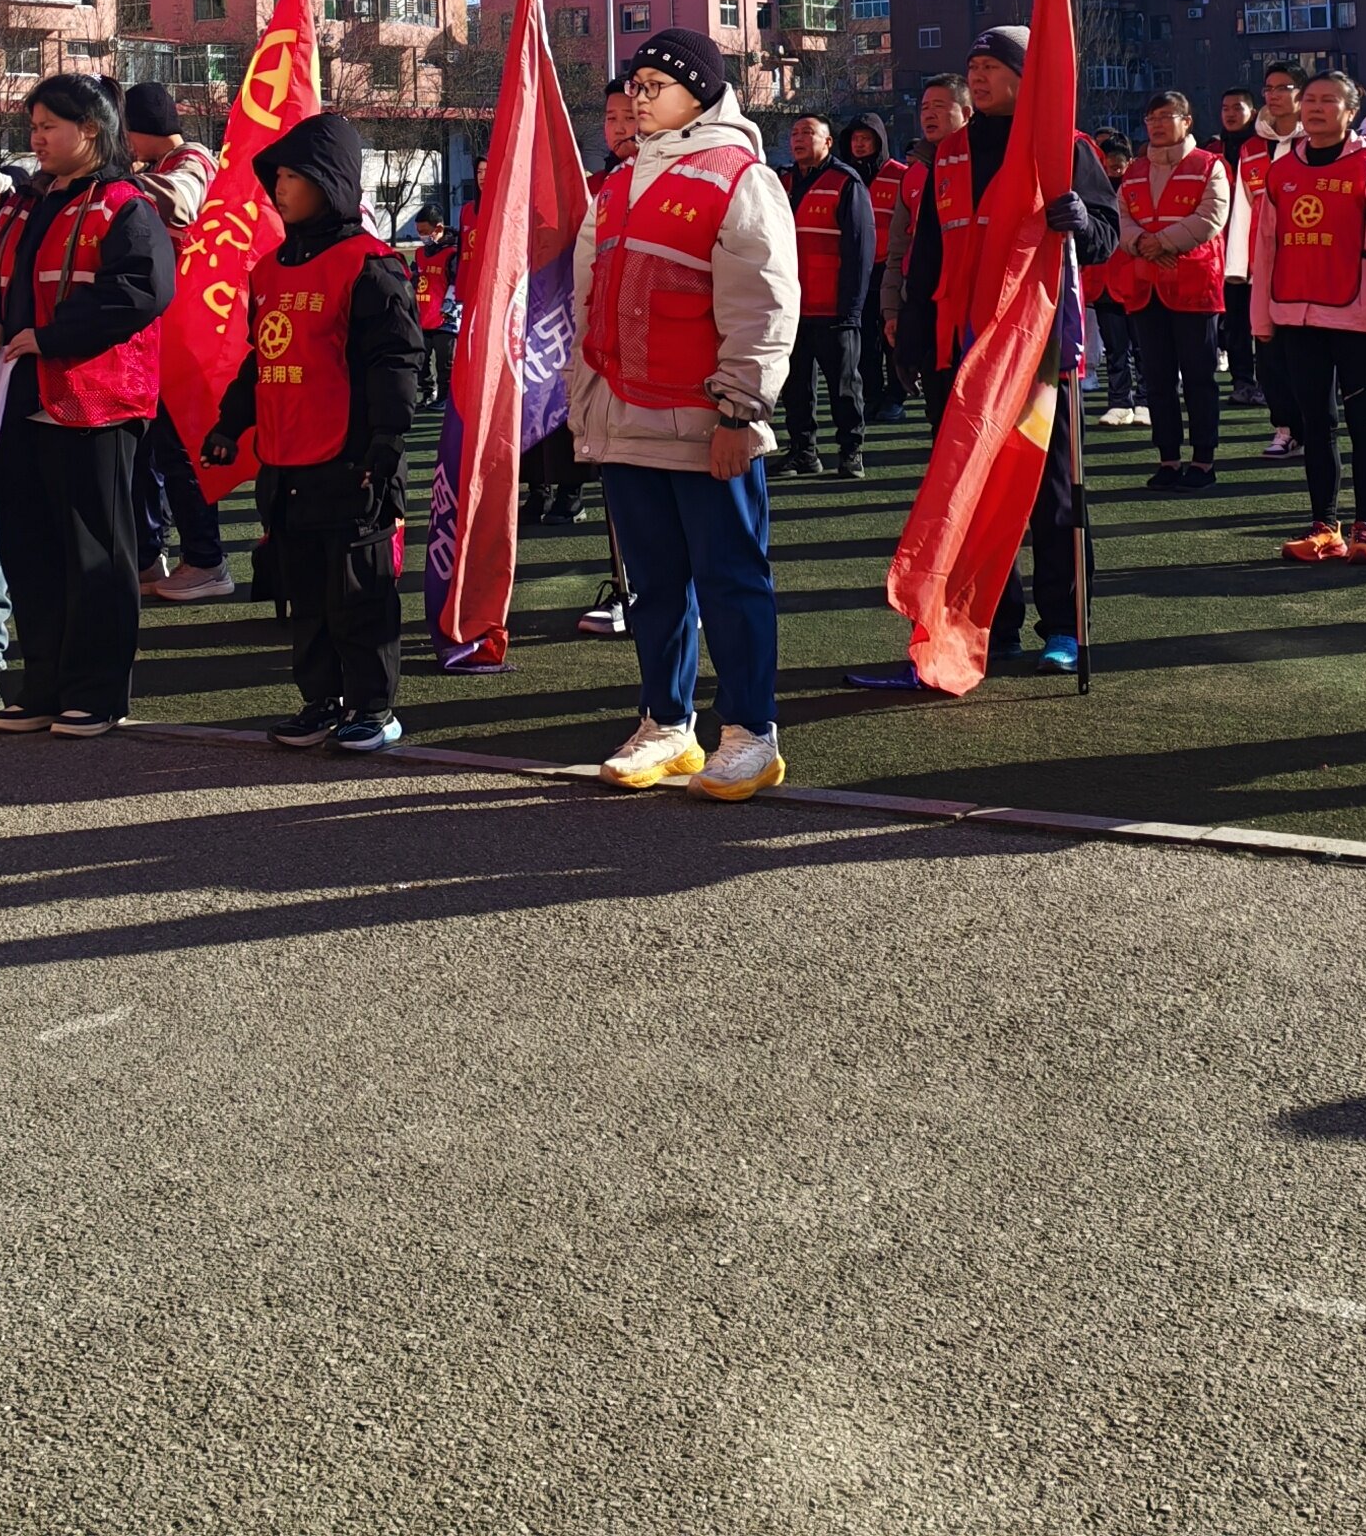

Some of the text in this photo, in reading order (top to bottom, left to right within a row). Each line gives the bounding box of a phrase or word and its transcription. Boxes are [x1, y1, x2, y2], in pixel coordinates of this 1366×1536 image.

[1315, 178, 1353, 194] 志愿者
[659, 197, 698, 223] 志愿者
[1284, 232, 1333, 246] 爱民拥警
[278, 292, 325, 312] 志愿者
